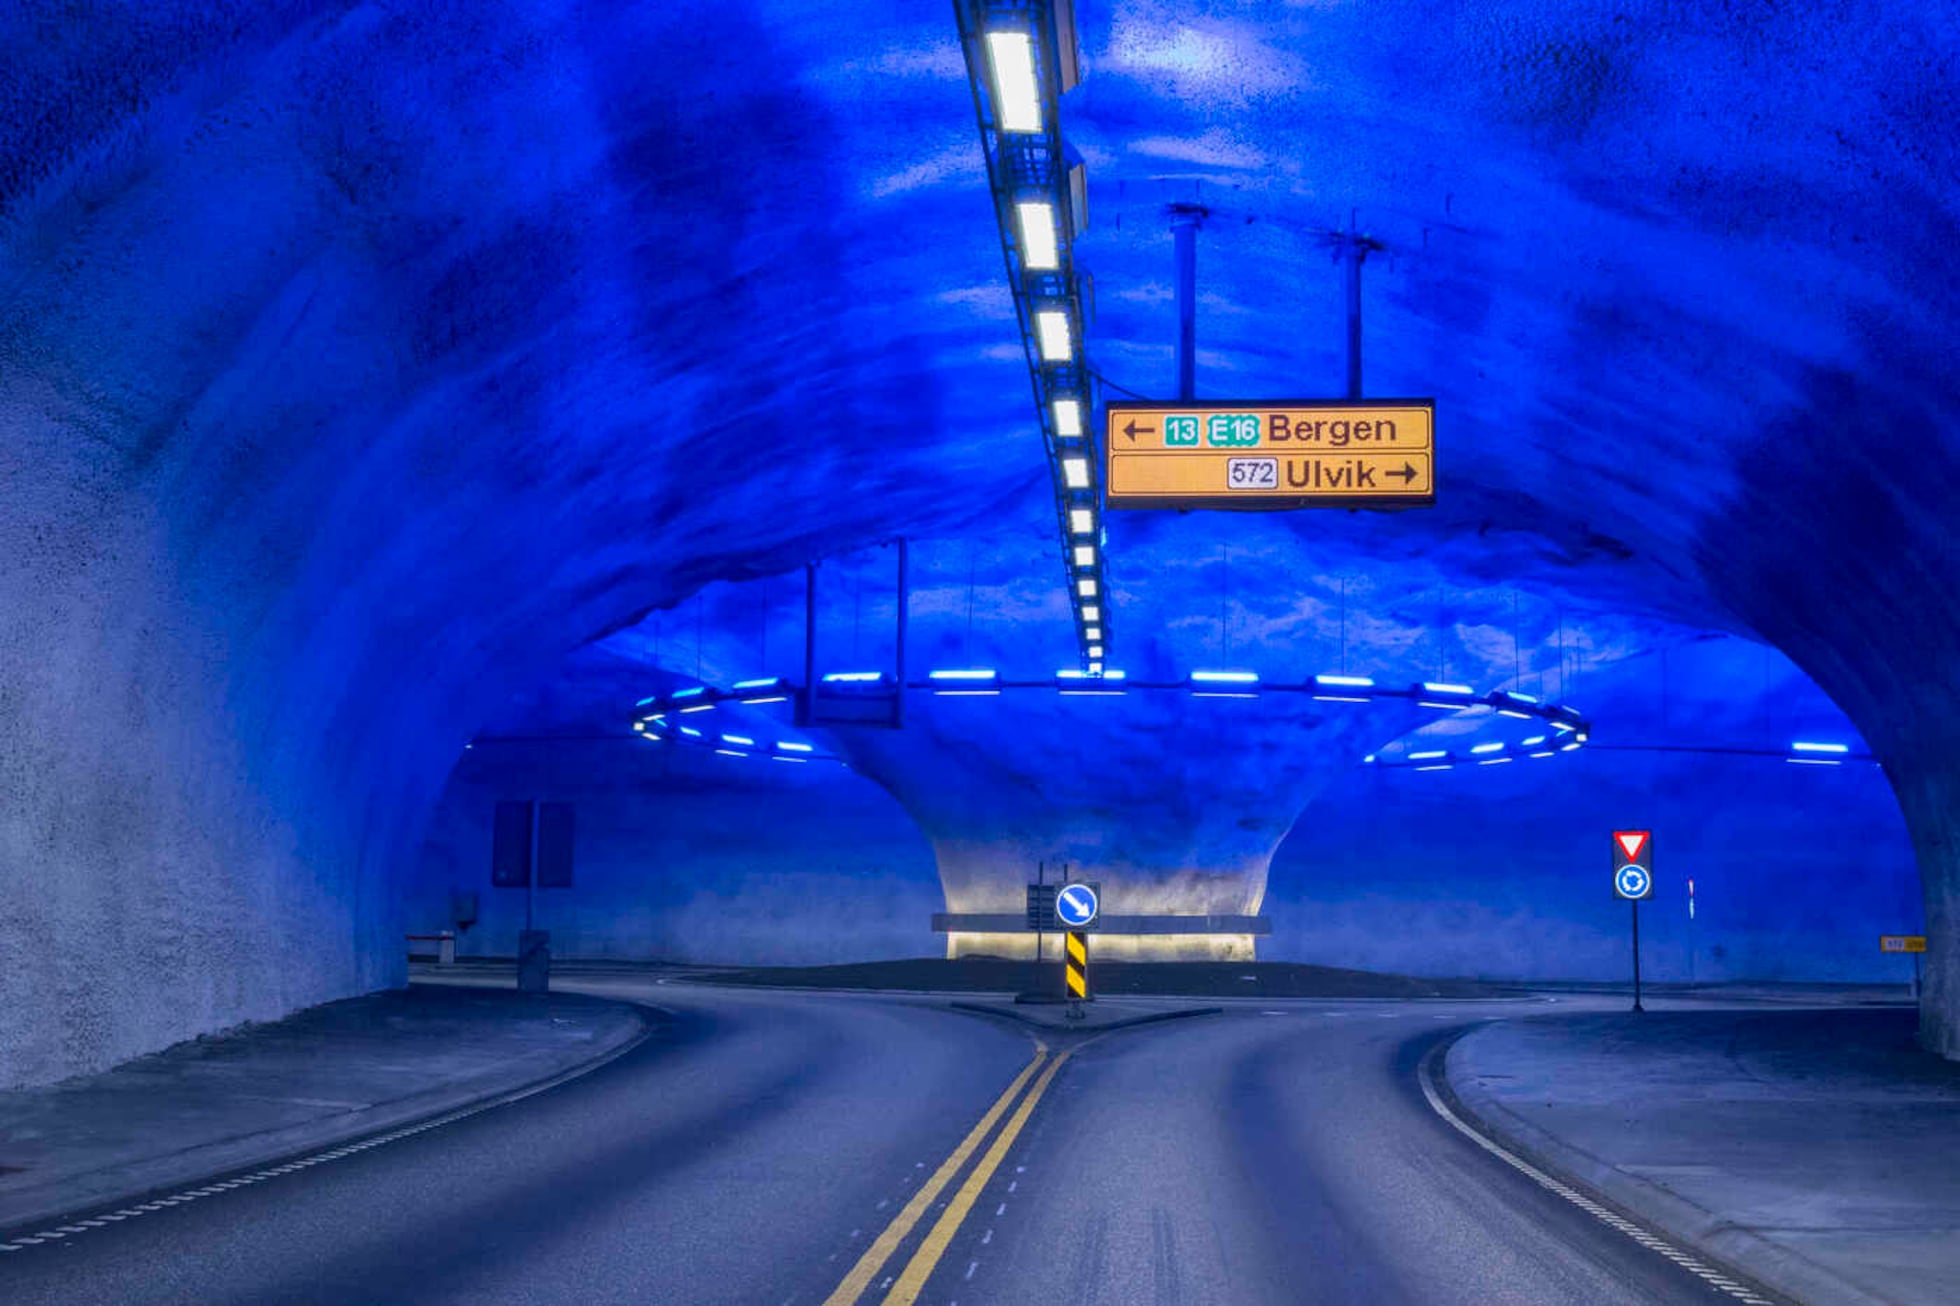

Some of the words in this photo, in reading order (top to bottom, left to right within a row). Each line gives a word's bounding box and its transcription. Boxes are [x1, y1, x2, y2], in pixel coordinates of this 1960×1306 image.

[1168, 419, 1196, 441] 13
[1211, 418, 1256, 441] E16
[1268, 414, 1397, 446] Bergen
[1231, 462, 1274, 483] 572
[1287, 460, 1376, 488] Ulvik
